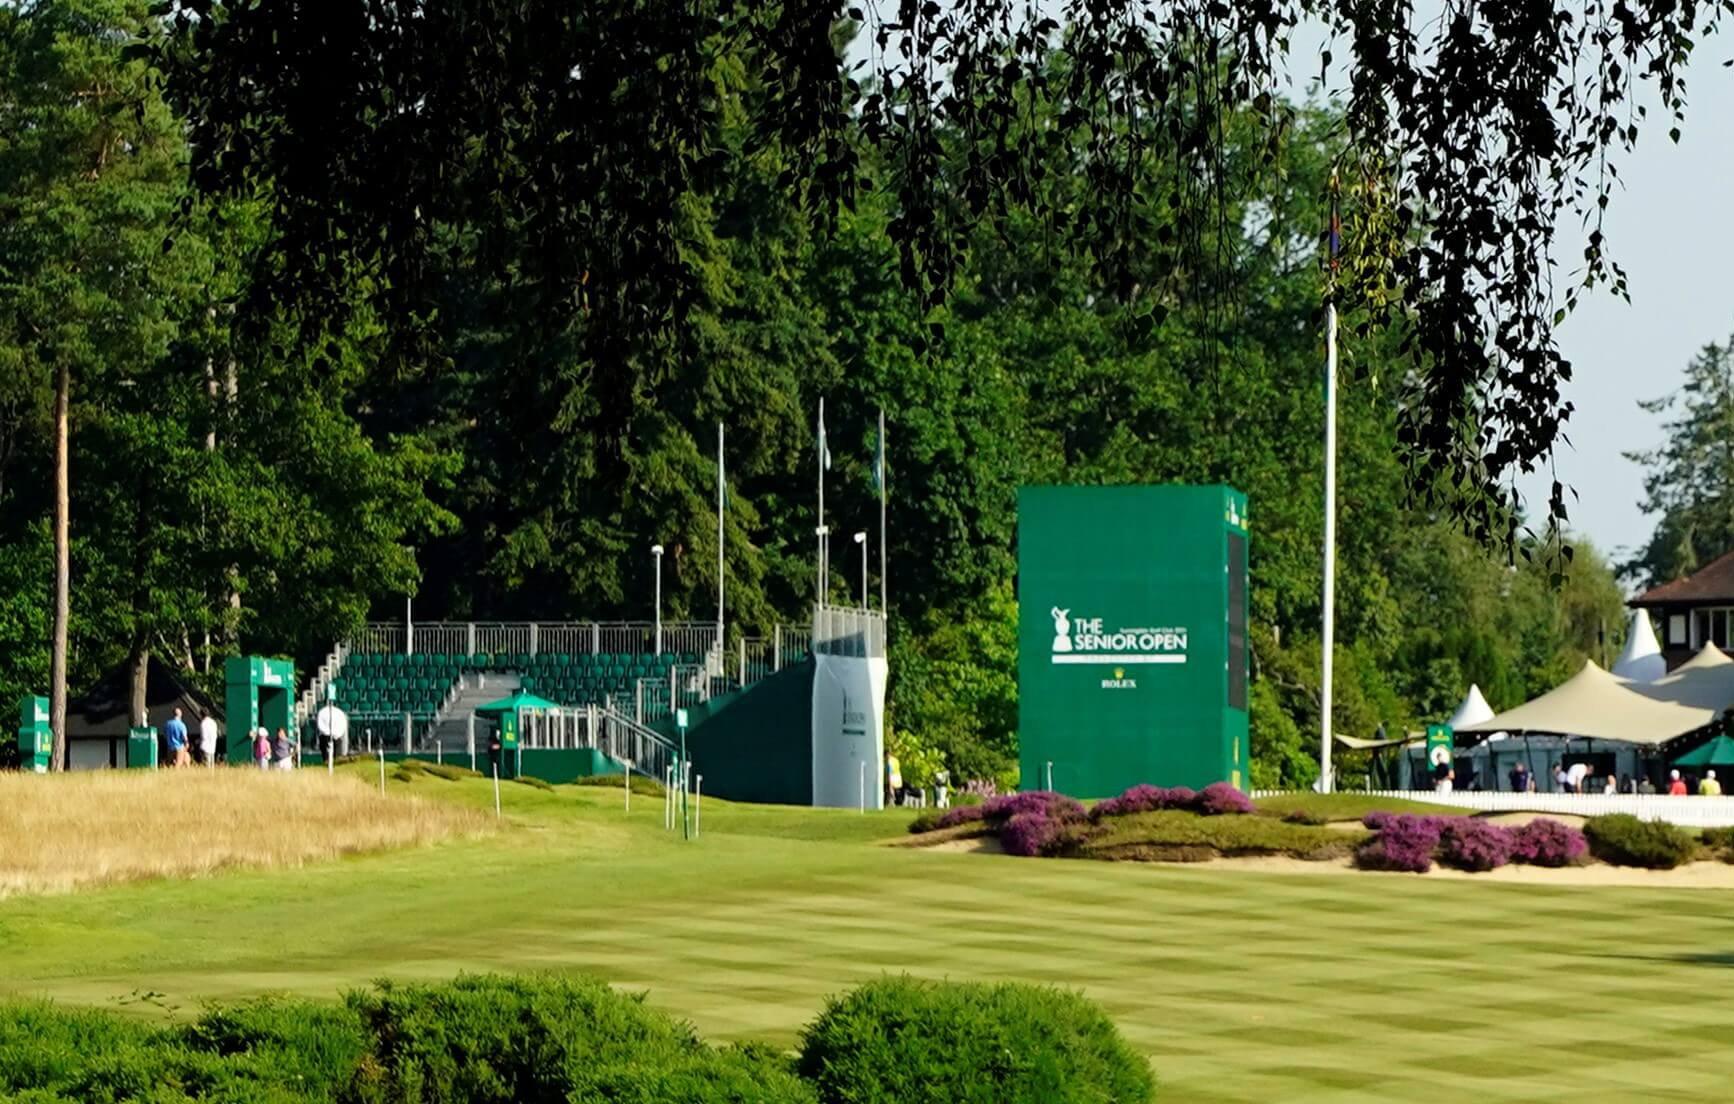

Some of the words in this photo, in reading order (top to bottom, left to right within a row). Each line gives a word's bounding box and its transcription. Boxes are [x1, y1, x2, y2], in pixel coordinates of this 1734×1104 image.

[1074, 618, 1103, 634] THE
[1075, 634, 1138, 650] SENIOR
[1139, 634, 1187, 650] OPEN
[1102, 679, 1137, 689] ROLEX
